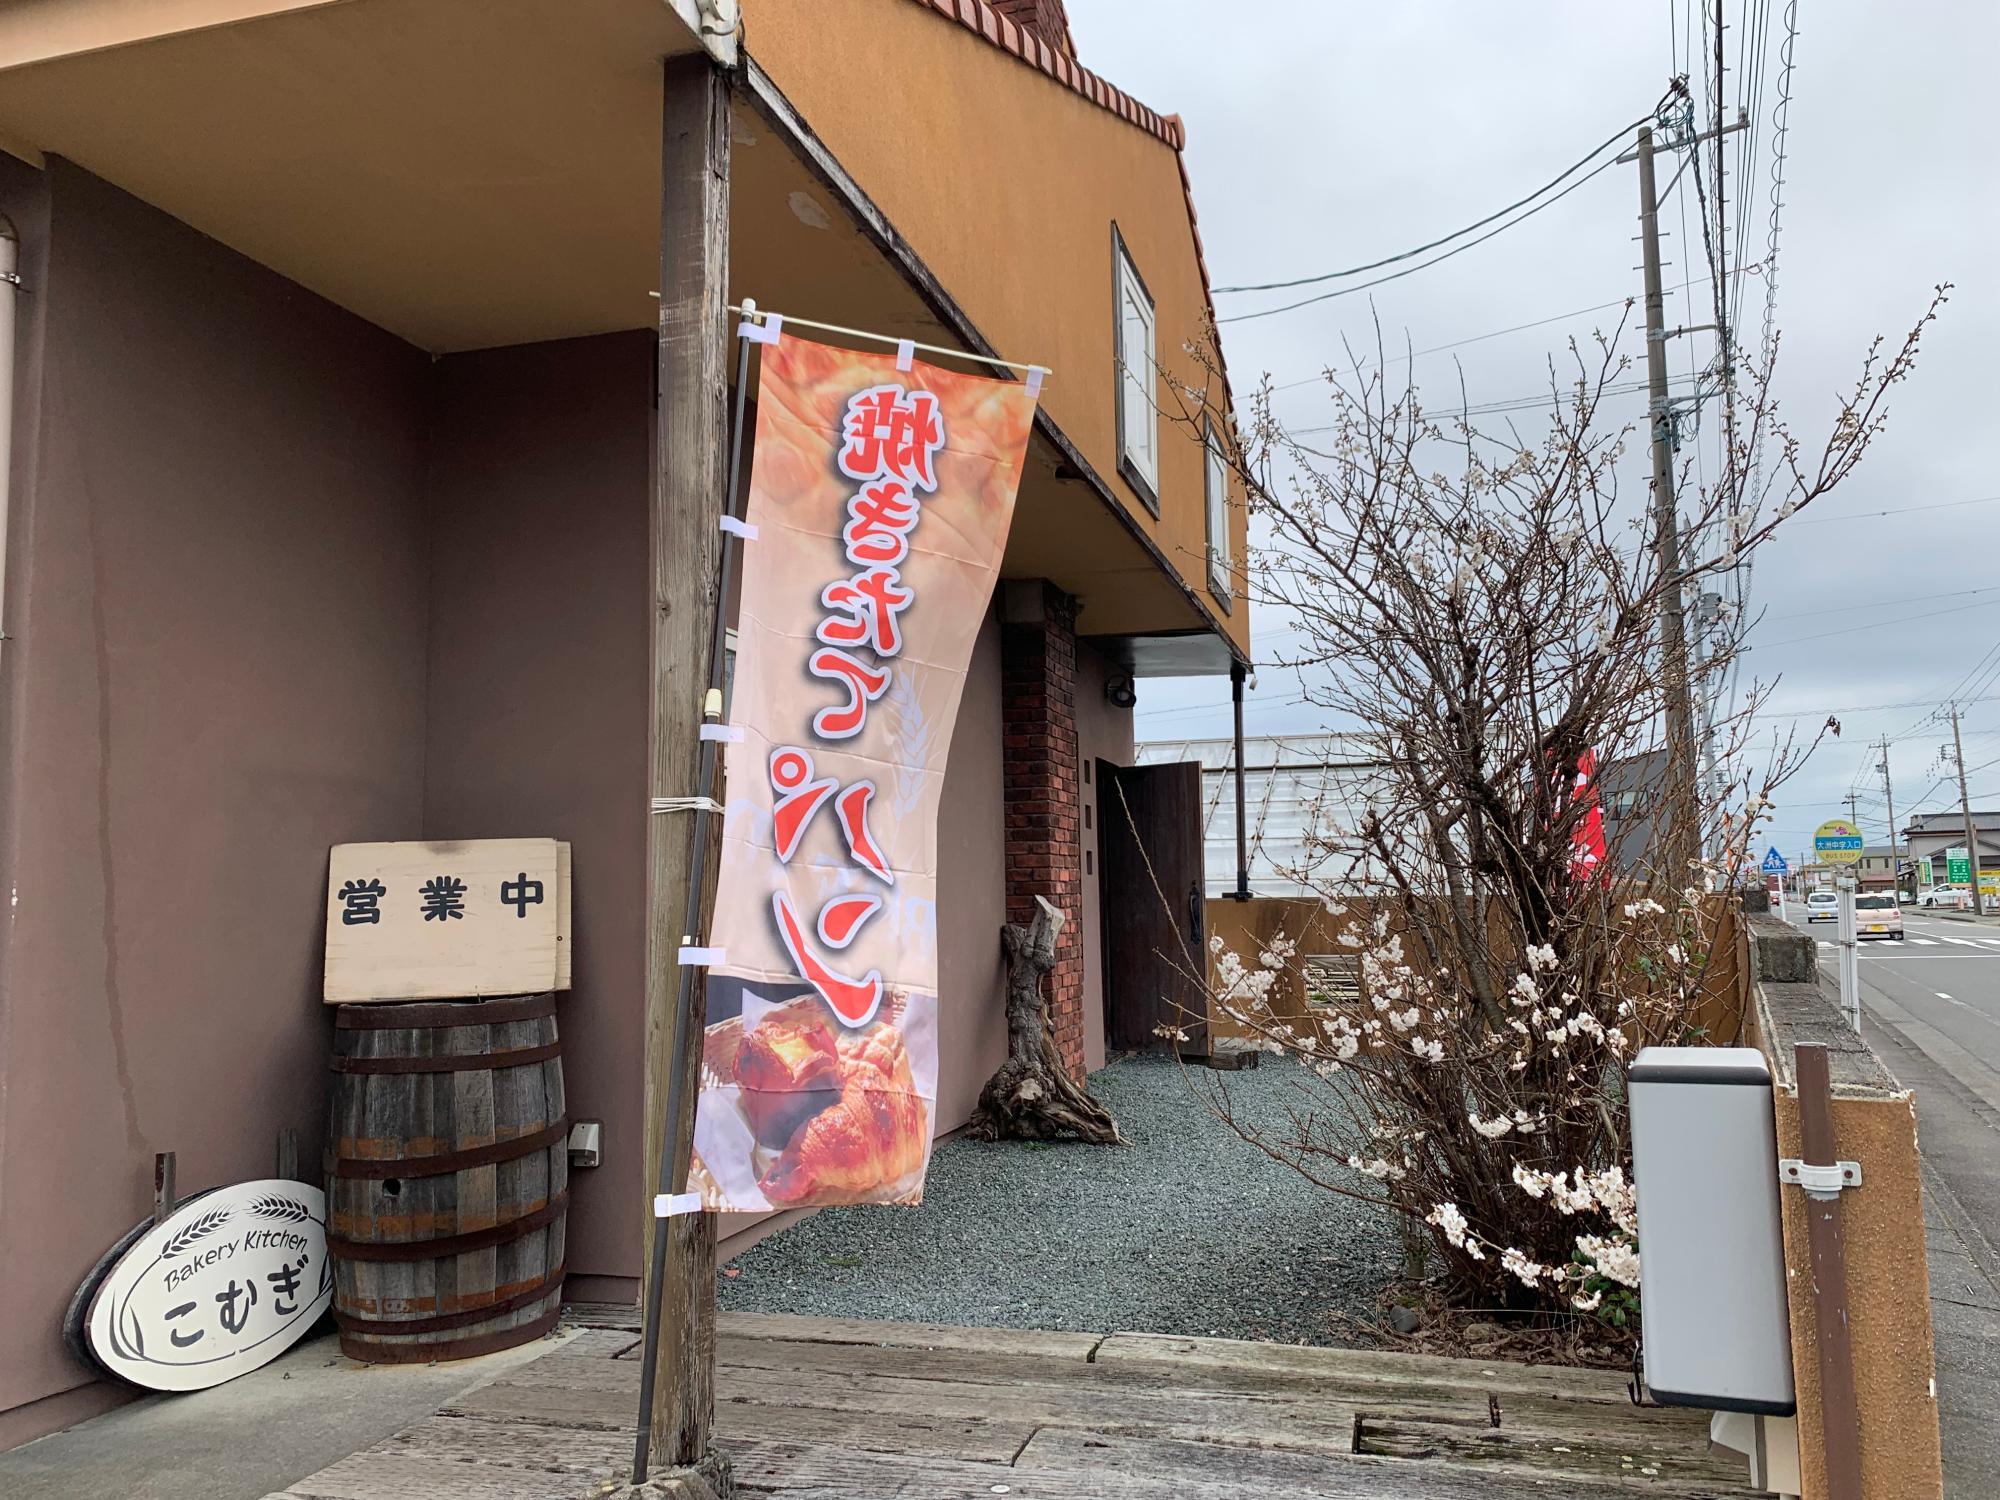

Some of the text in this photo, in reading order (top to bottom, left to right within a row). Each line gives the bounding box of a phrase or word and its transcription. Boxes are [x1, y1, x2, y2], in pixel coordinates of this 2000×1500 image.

[337, 872, 544, 926] 営業中
[163, 1229, 308, 1293] Bakery Kitchen
[164, 1253, 310, 1348] こむぎ
